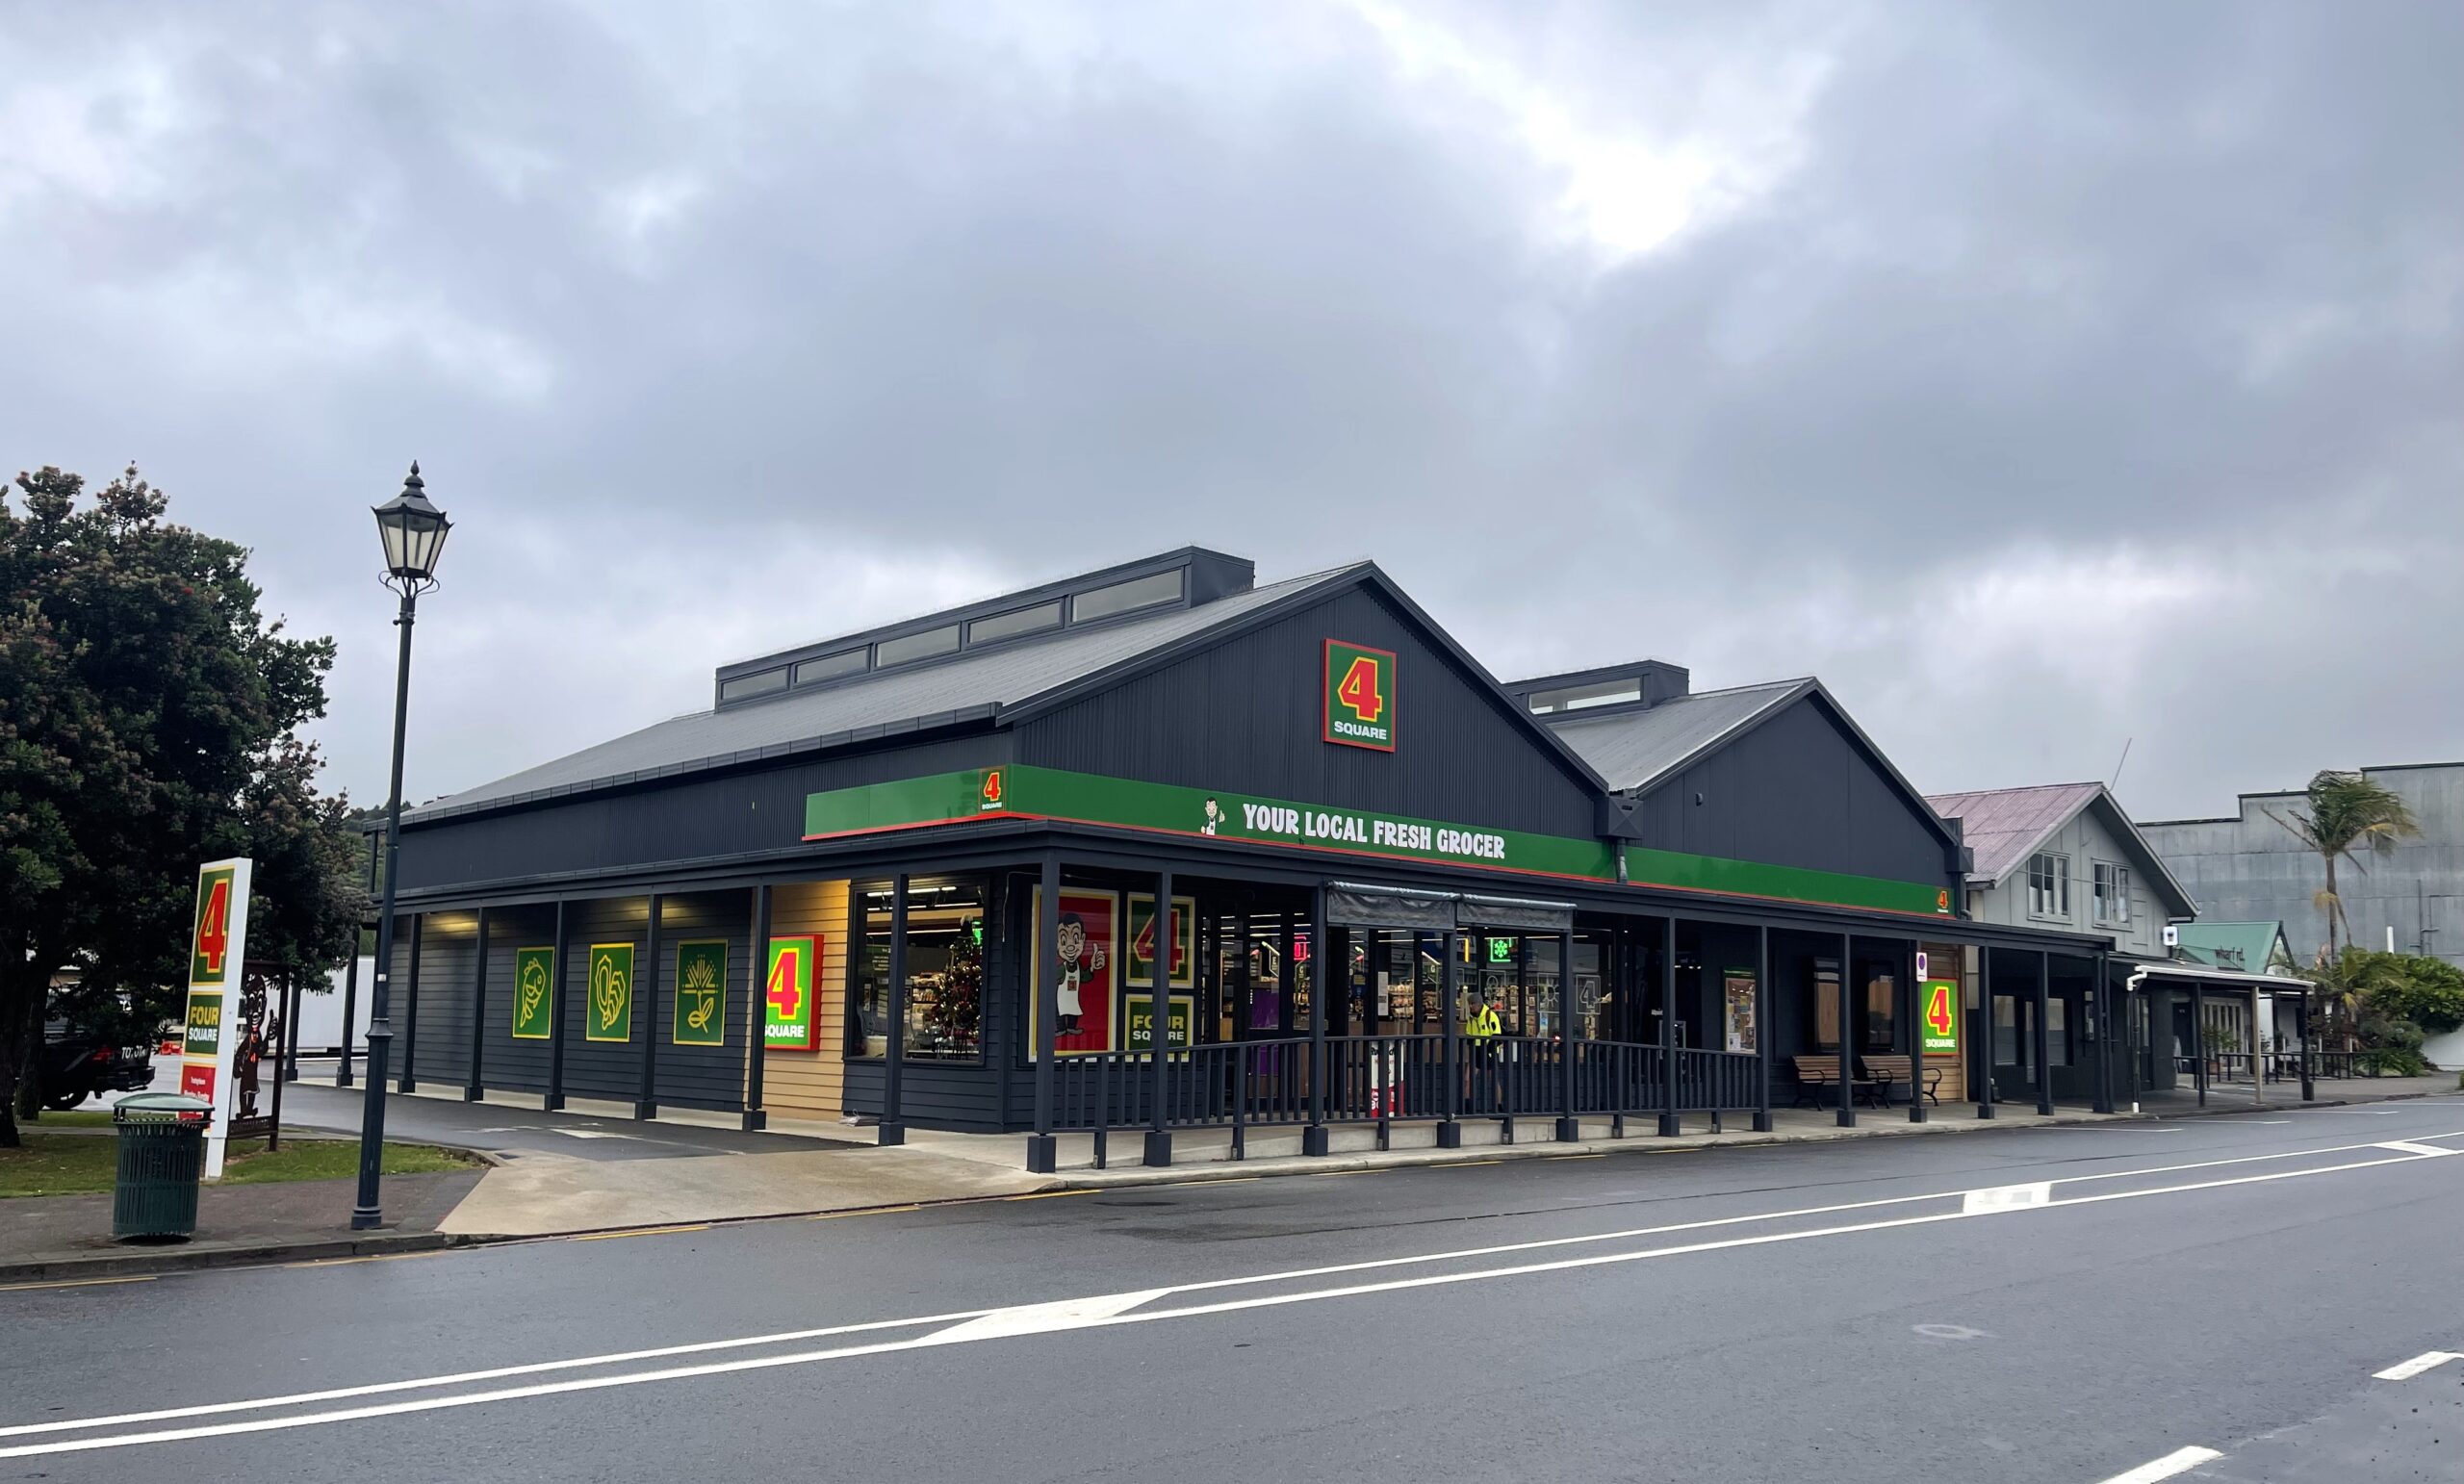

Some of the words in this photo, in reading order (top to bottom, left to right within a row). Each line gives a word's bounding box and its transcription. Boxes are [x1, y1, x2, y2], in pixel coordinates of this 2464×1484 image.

[1338, 656, 1382, 722] 4
[1334, 721, 1387, 740] SQUARE
[984, 772, 1001, 802] 4
[1243, 804, 1299, 834] YOUR
[1305, 811, 1368, 843] LOCAL
[1373, 820, 1431, 850] FRESH
[1436, 829, 1505, 859] GROCER
[1938, 890, 1948, 908] 4
[197, 879, 229, 973] 4
[1133, 908, 1185, 975] 4
[767, 948, 802, 1020] 4
[190, 1006, 219, 1026] FOUR
[1926, 986, 1952, 1036] 4
[188, 1026, 218, 1042] SQUARE
[1132, 1030, 1185, 1042] SQRE
[1925, 1038, 1956, 1049] SQUARE
